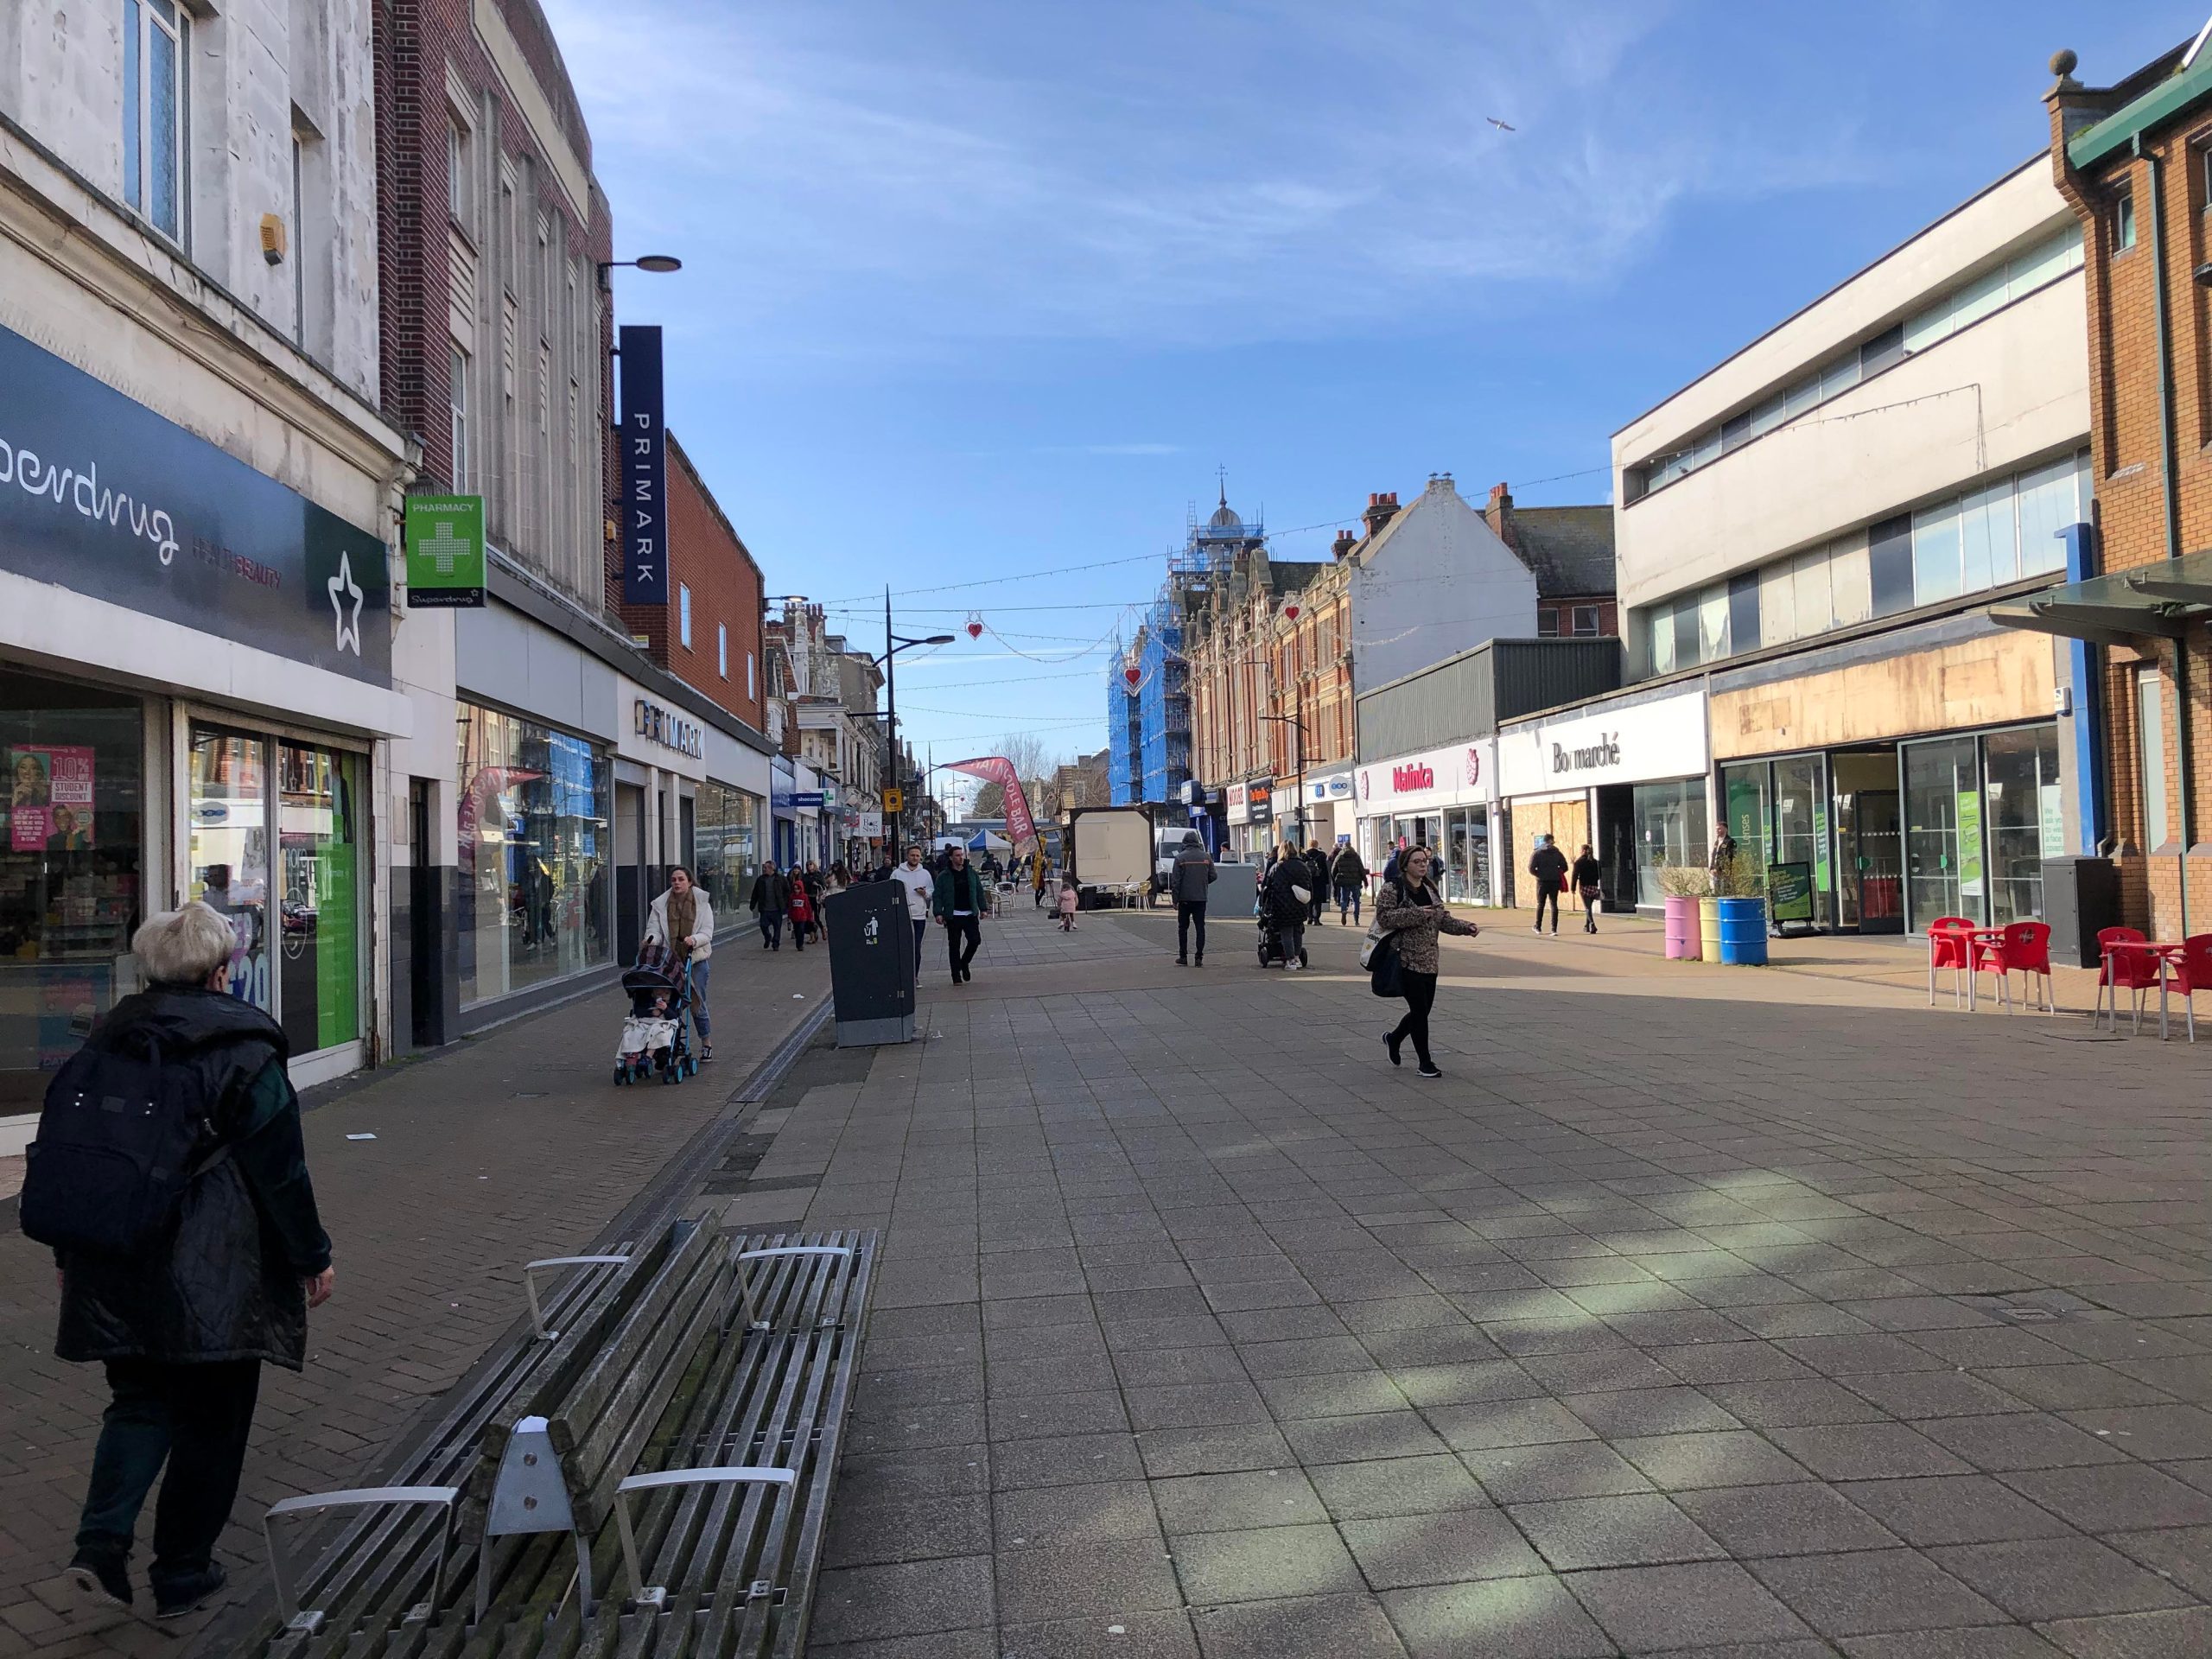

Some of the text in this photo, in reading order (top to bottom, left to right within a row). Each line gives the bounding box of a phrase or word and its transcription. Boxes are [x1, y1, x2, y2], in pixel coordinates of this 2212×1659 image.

[412, 504, 474, 512] PHARMACY
[633, 413, 654, 582] PRIMARK
[410, 594, 474, 604] Superdrug
[635, 699, 704, 760] PRIMARK
[54, 782, 88, 792] STUDENT
[1393, 762, 1433, 793] Malinka
[1010, 807, 1028, 834] BAR
[1741, 814, 1750, 845] Lenses
